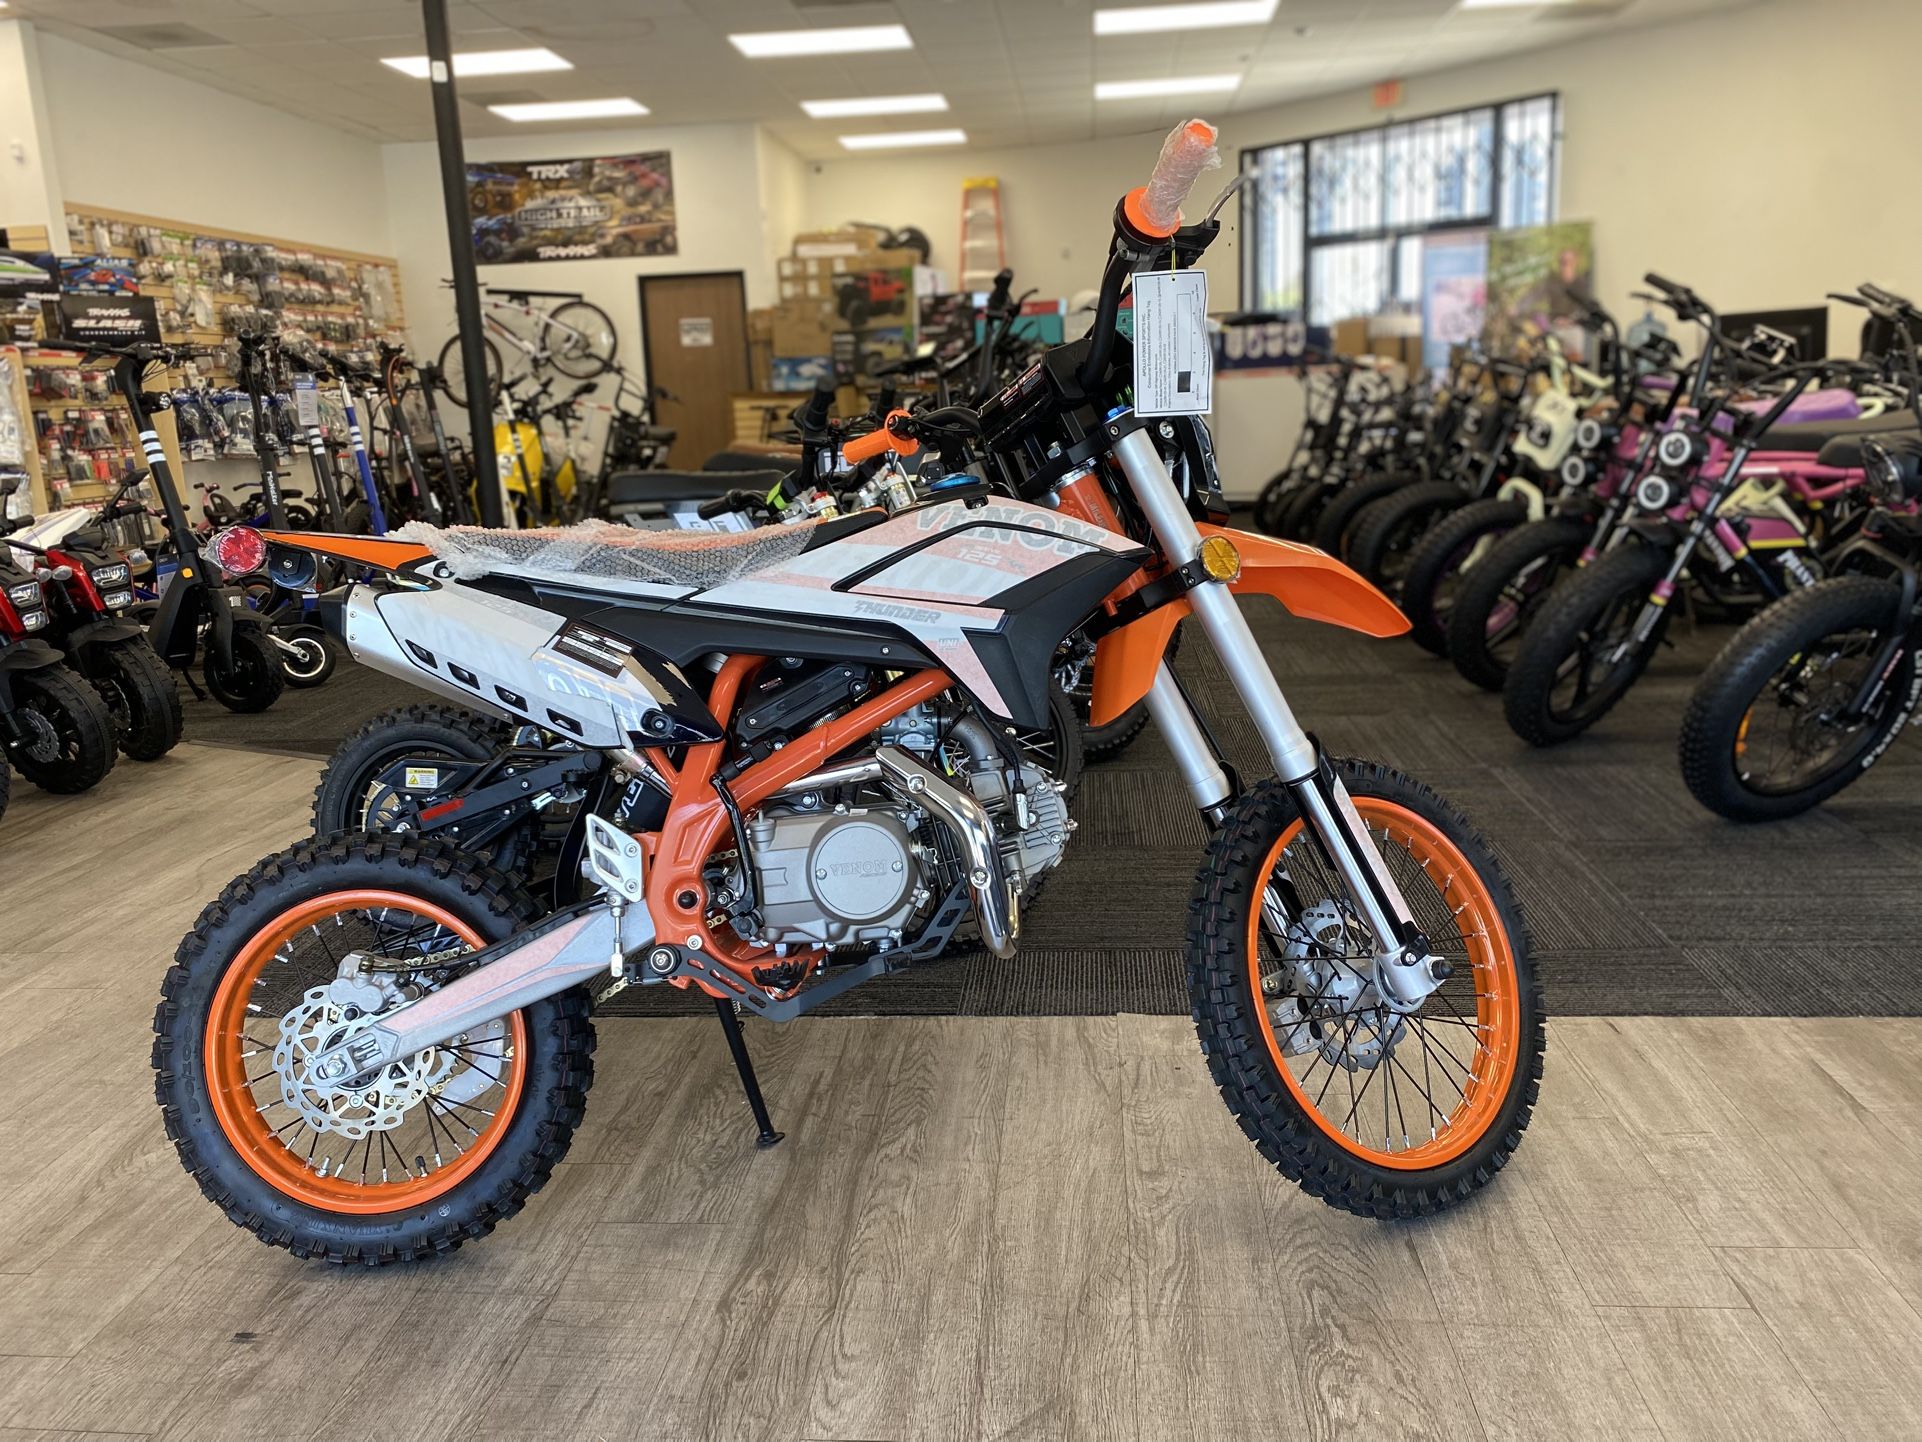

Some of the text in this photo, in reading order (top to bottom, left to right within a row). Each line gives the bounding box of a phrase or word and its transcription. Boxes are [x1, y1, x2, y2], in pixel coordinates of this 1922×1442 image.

[916, 504, 1108, 557] VENOM
[854, 600, 942, 624] THUNDER
[829, 859, 889, 877] VENOM
